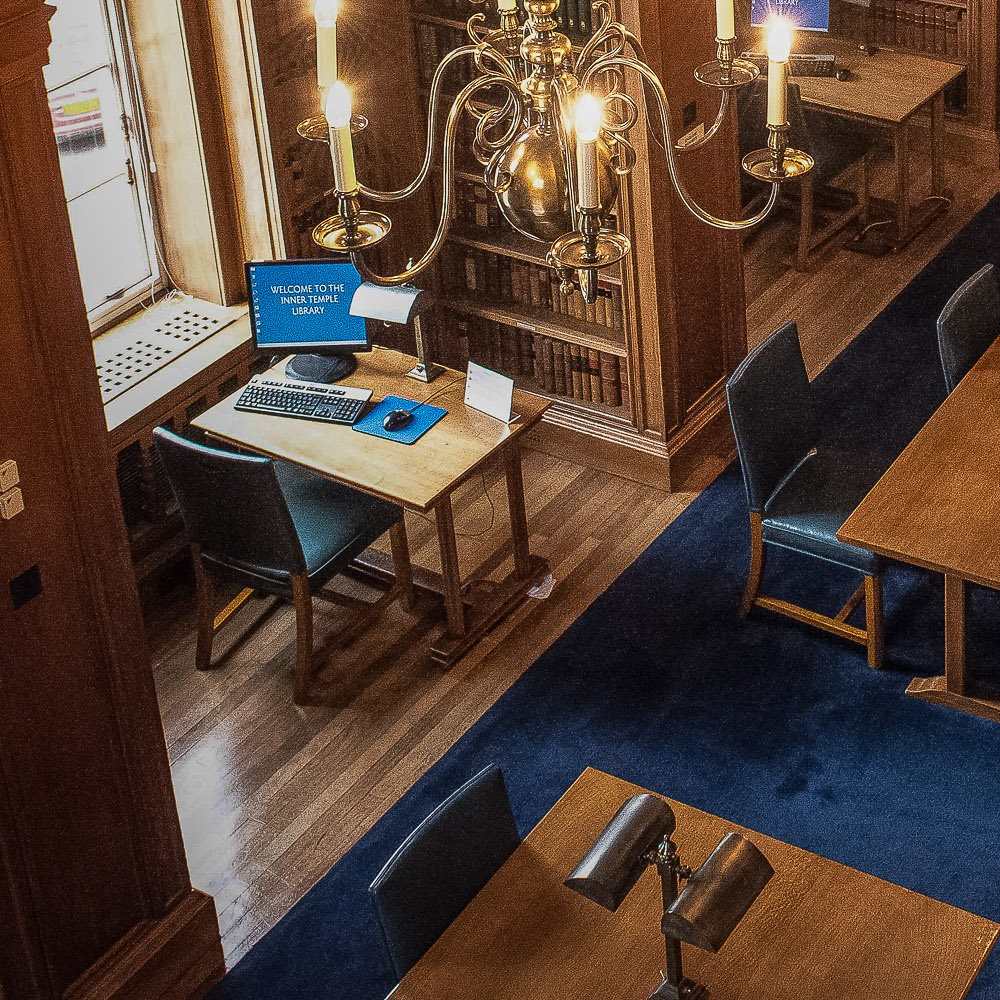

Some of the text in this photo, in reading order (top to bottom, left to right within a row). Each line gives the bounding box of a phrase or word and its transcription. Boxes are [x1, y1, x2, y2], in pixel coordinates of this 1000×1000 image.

[270, 283, 345, 294] WELCOME TO THE
[280, 294, 339, 304] INNER TEMPLE
[292, 306, 325, 315] LIBRARY
